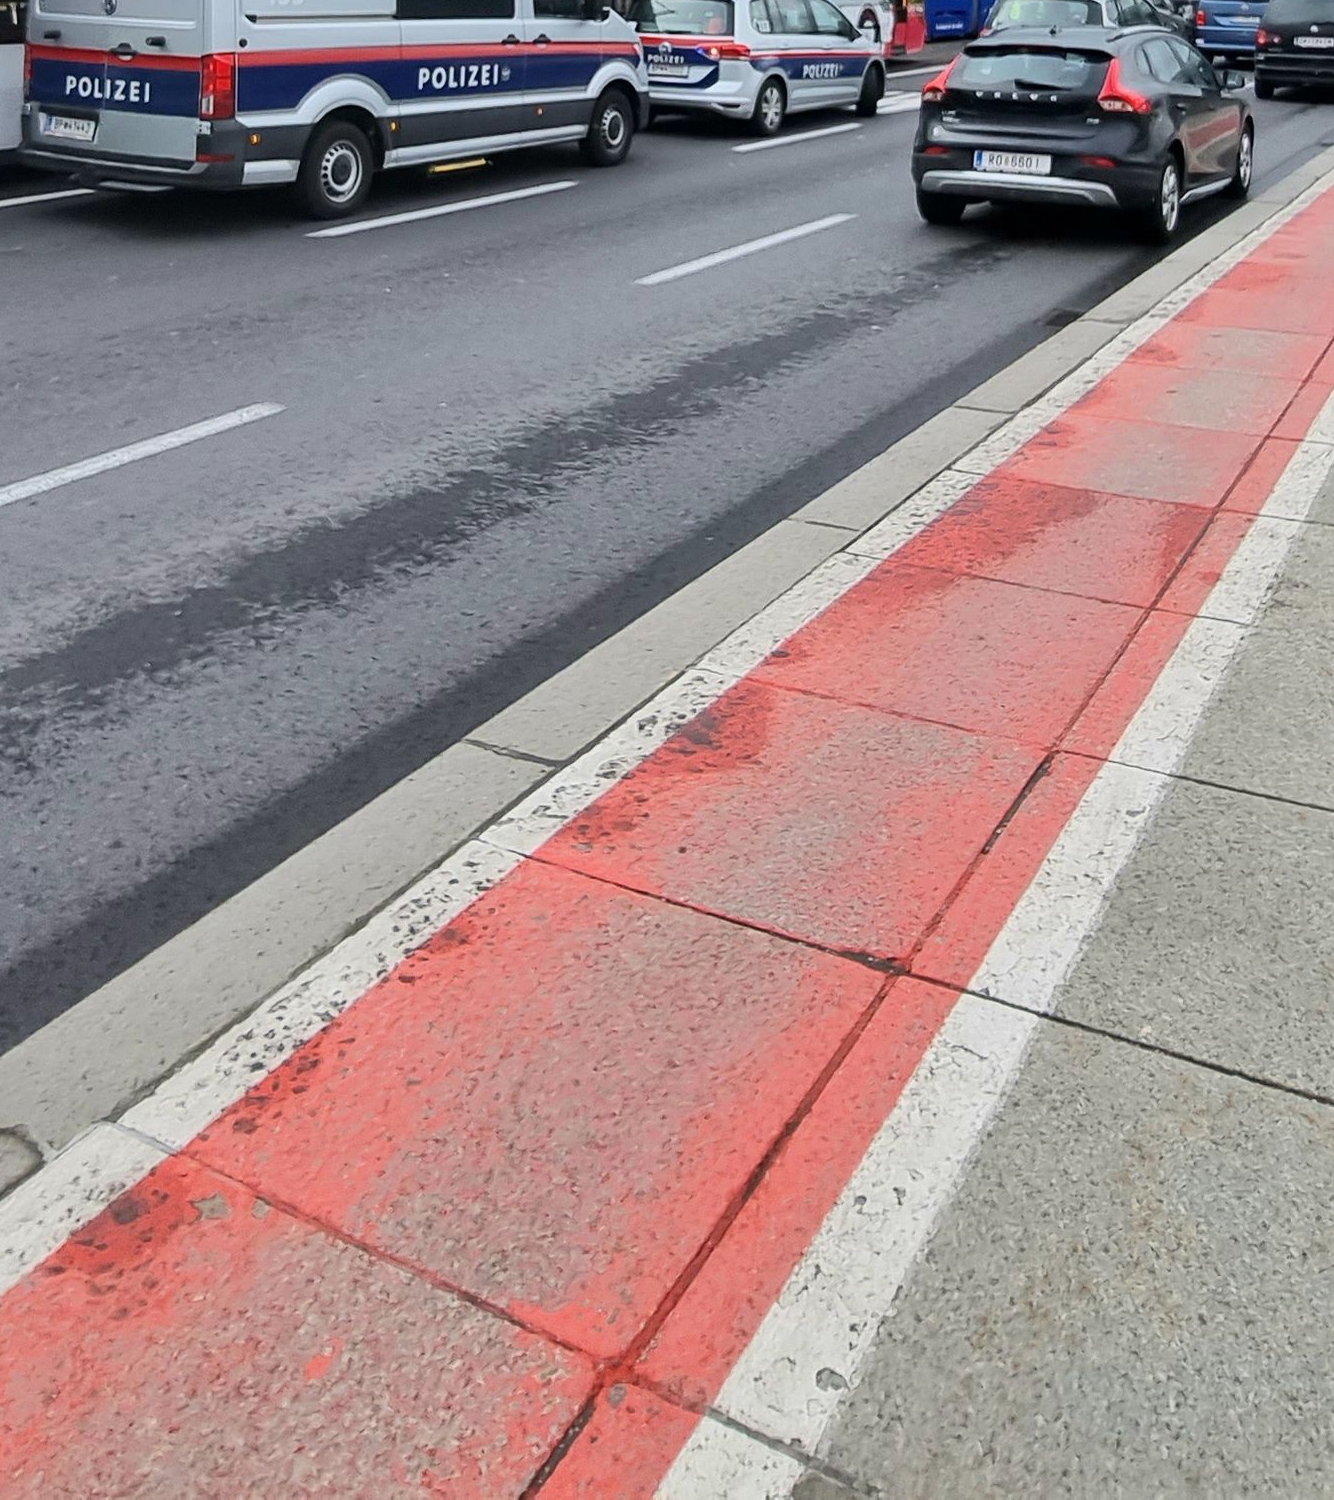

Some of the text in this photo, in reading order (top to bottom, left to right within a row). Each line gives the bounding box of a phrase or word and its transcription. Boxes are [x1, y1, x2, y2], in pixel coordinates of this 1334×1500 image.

[647, 54, 684, 64] POLIZEI
[418, 63, 499, 90] POLIZEI
[803, 63, 839, 78] POLIZEI
[66, 75, 150, 103] POLIZEI
